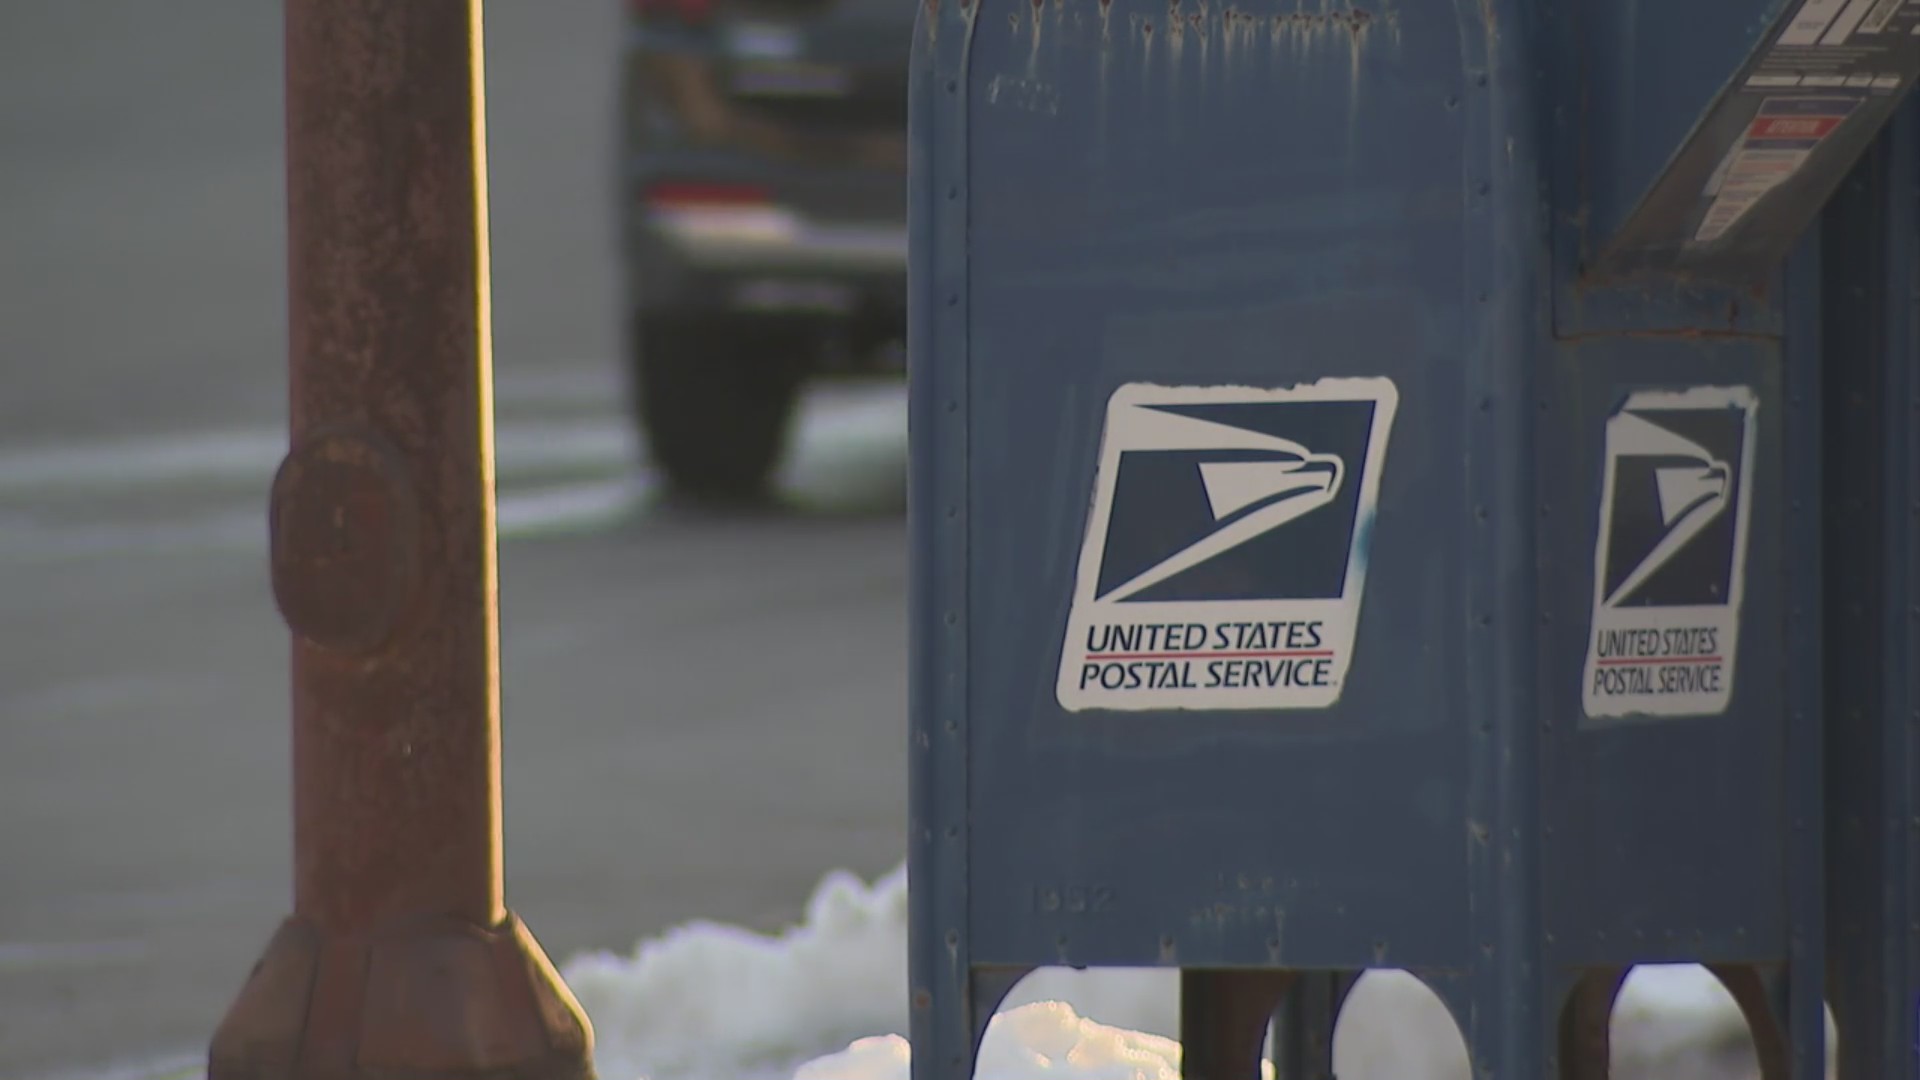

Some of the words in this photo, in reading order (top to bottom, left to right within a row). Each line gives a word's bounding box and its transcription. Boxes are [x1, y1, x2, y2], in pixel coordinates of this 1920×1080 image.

[1086, 623, 1207, 652] UNITED
[1212, 621, 1322, 649] STATES
[1597, 629, 1659, 656] UNITED
[1661, 626, 1717, 655] STATES
[1079, 662, 1197, 690] POSTAL
[1204, 659, 1332, 688] SERVICE
[1593, 667, 1654, 695] POSTAL
[1657, 664, 1721, 693] SERVICE
